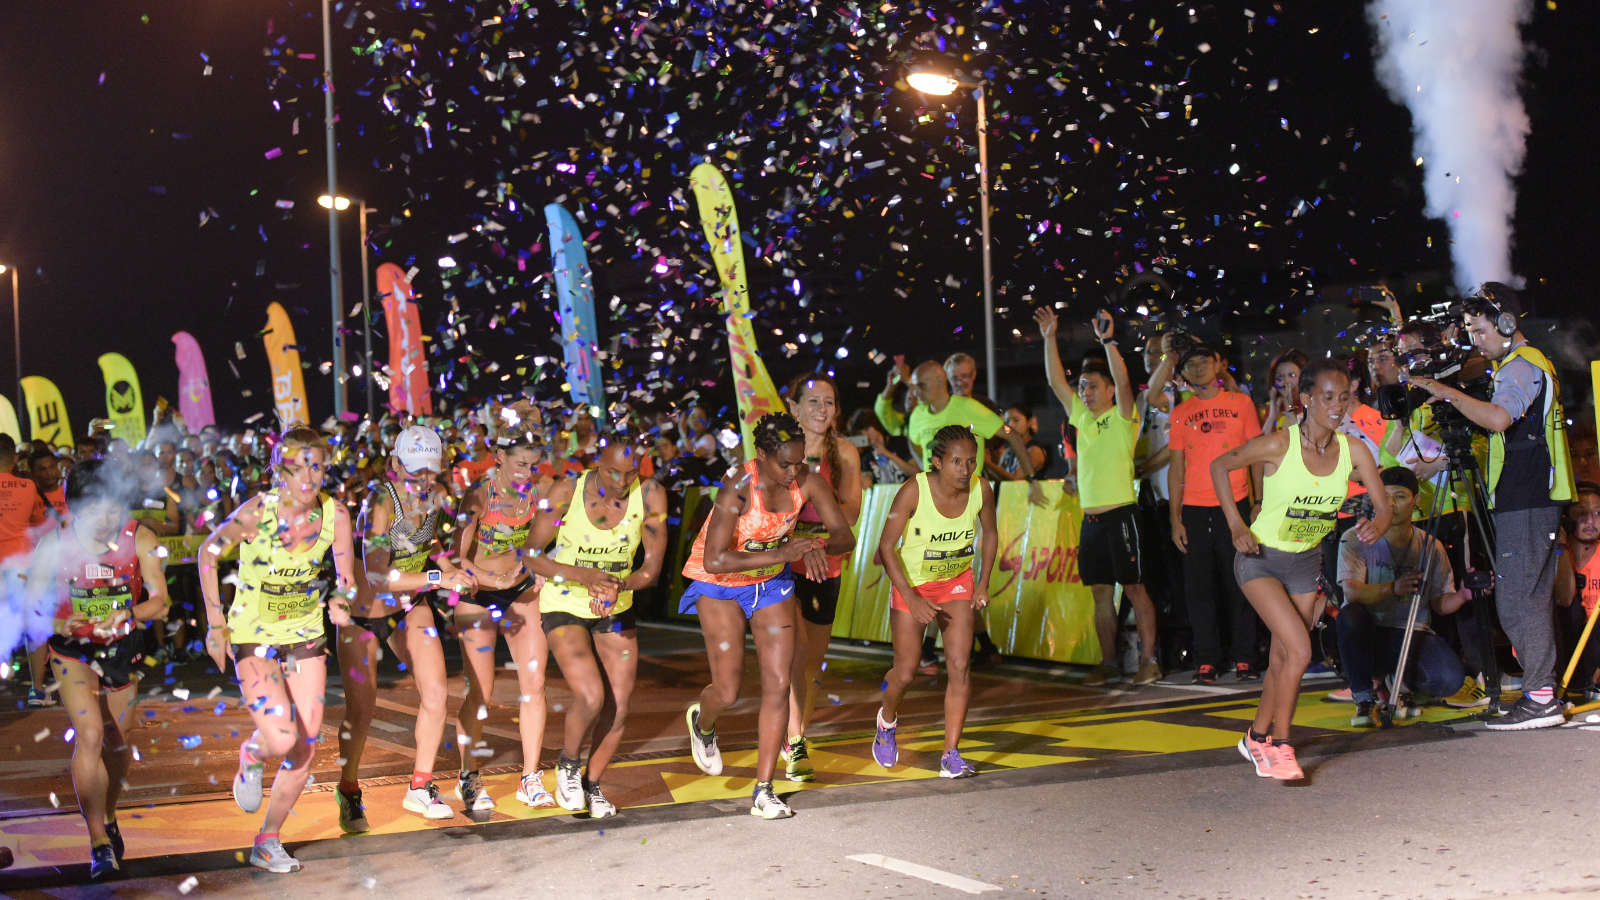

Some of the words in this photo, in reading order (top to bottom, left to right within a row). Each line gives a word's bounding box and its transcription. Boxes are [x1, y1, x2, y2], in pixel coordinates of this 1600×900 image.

[1212, 407, 1239, 418] CREW
[1293, 495, 1342, 505] MOVE
[930, 529, 974, 542] MOVE
[578, 544, 630, 555] MOVE
[268, 567, 317, 577] MOVE
